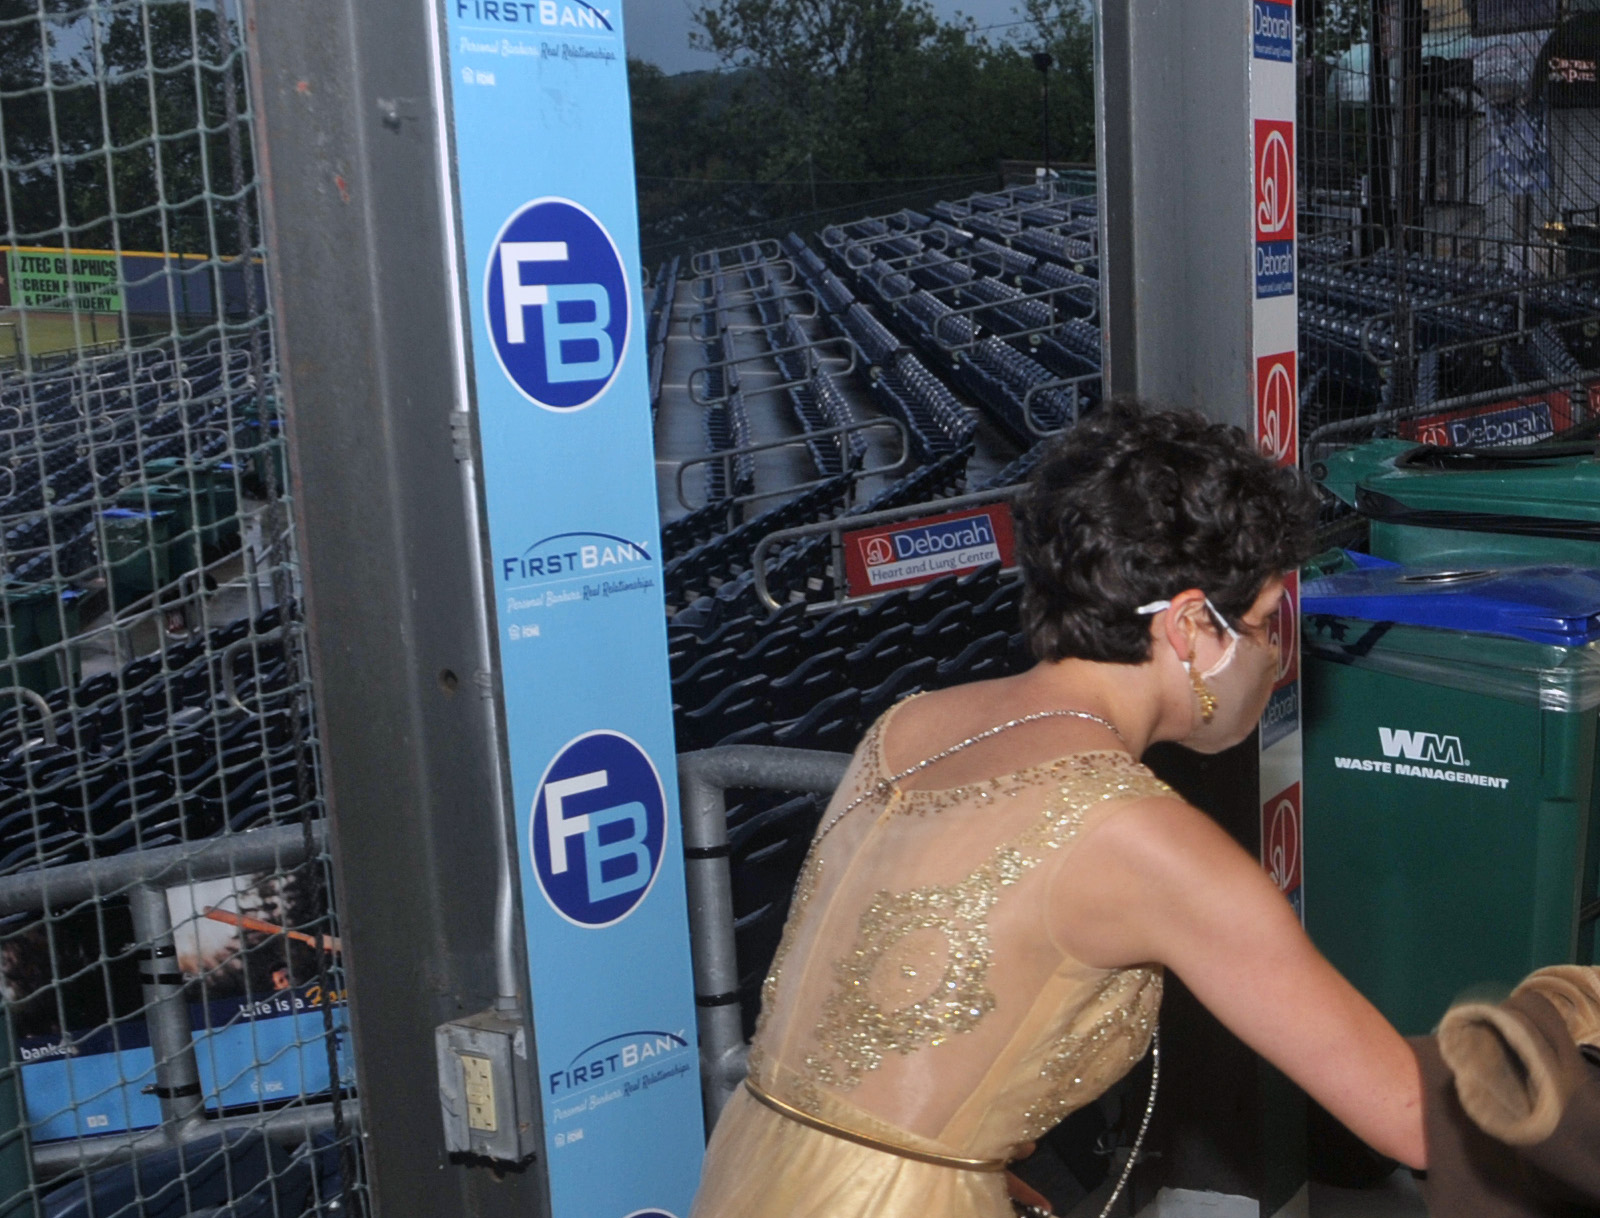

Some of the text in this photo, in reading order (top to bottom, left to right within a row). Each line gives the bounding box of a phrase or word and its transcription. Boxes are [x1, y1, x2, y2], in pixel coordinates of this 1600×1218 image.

[1255, 4, 1291, 39] Deborah
[1257, 245, 1293, 277] Deborah
[500, 241, 615, 384] FB
[1452, 411, 1546, 447] Deborah
[894, 521, 990, 558] Deborah
[502, 541, 648, 581] FIRSTBANK
[871, 550, 995, 582] Heart and Lung Center
[1334, 757, 1509, 790] WASTE MANAGEMENT
[544, 769, 653, 904] FB
[275, 998, 290, 1012] is
[294, 998, 304, 1010] a
[549, 1029, 685, 1095] FIRSTBANK
